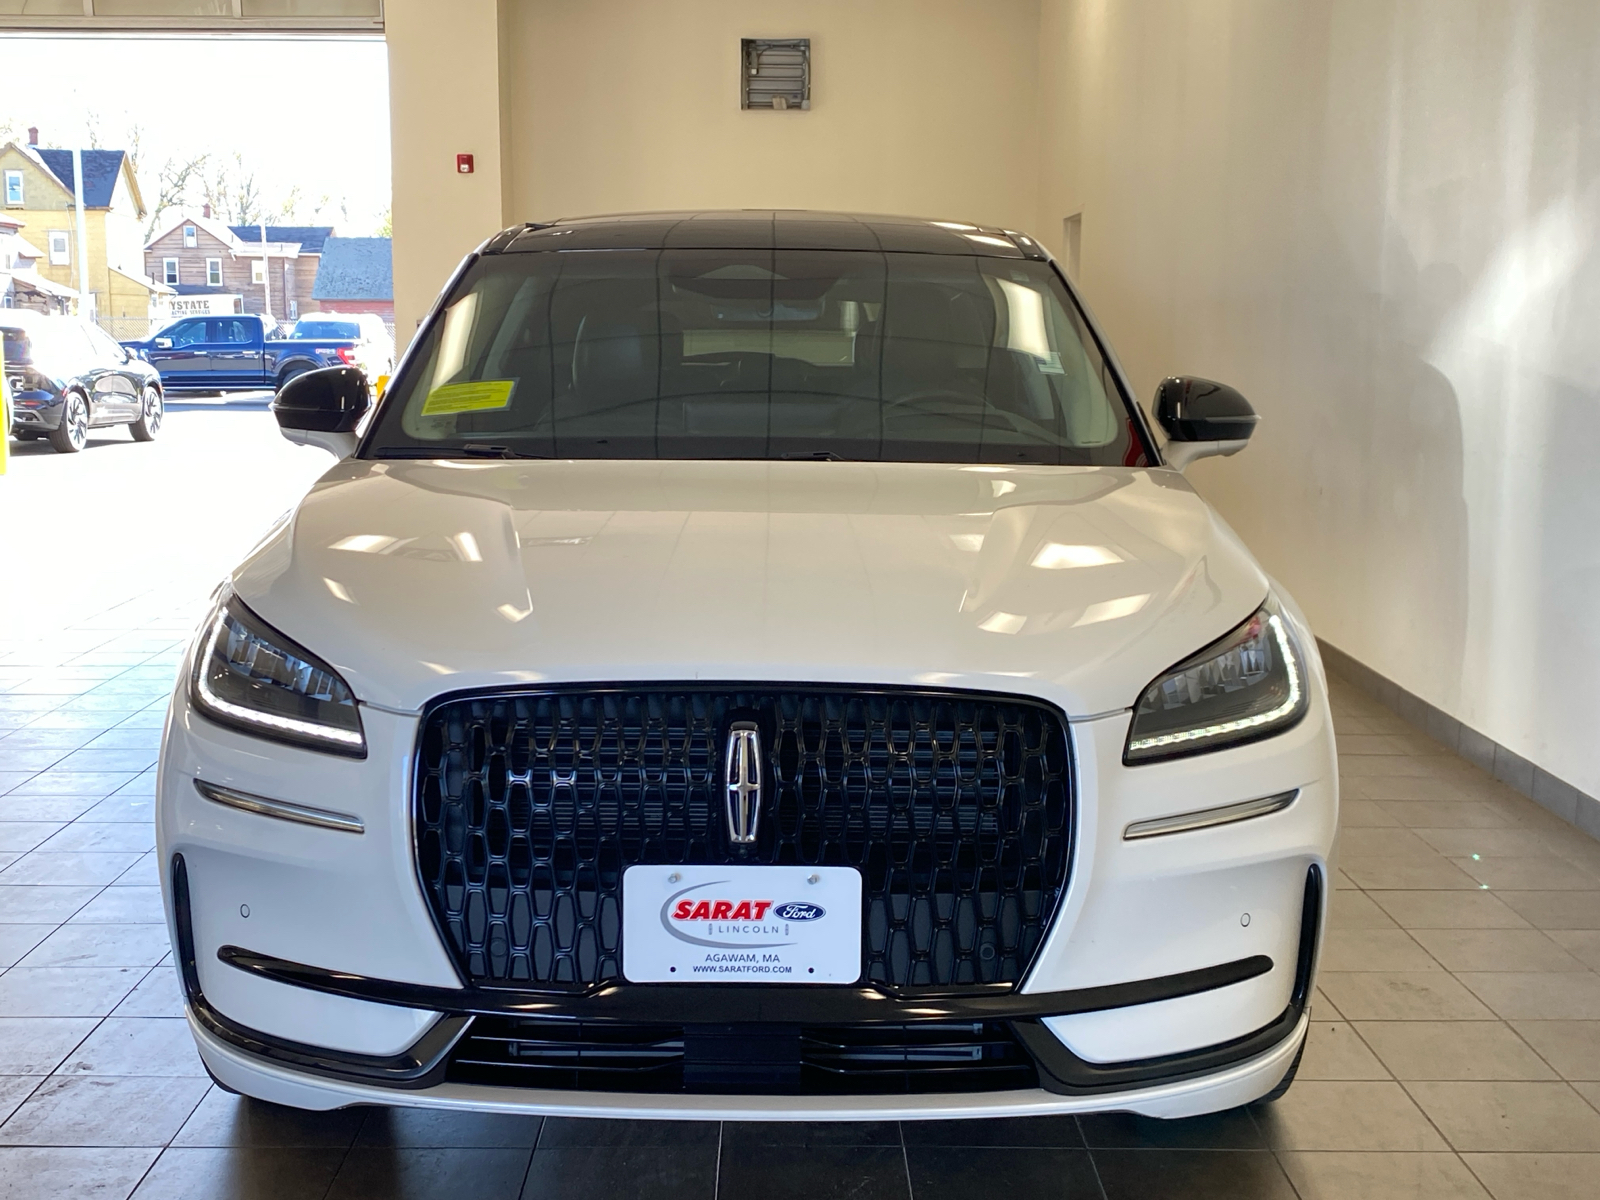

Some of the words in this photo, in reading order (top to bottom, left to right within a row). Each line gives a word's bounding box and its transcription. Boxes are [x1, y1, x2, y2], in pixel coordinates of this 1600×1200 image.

[671, 899, 774, 921] SARAT
[782, 904, 817, 919] Ford
[718, 925, 779, 934] LINCOLN
[705, 954, 759, 964] AGAWAM,
[762, 954, 780, 963] MA
[693, 965, 792, 974] WWW.SARATFORD.COM
